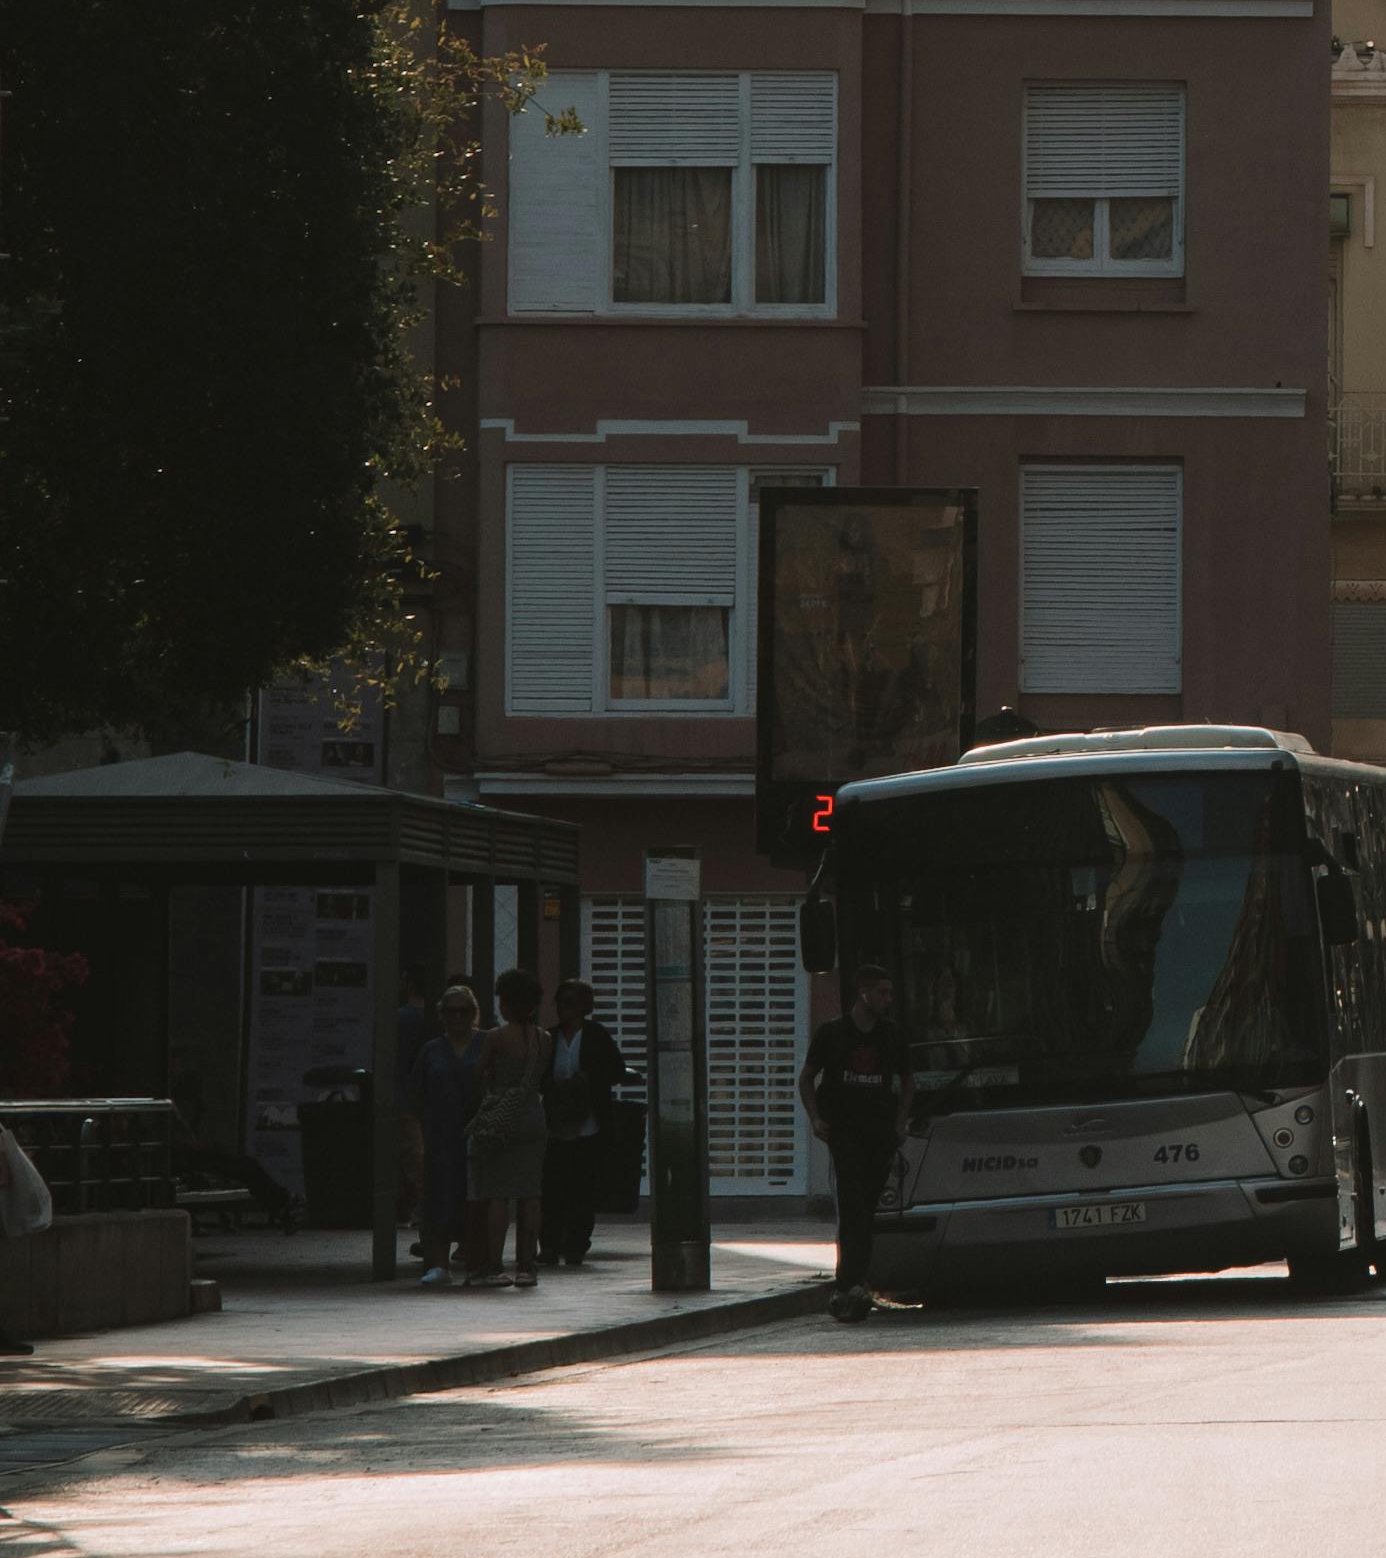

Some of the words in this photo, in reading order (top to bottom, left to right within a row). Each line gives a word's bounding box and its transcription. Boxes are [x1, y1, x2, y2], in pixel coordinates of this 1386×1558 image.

[1153, 1143, 1201, 1164] 476
[1063, 1208, 1104, 1227] 1741
[1110, 1203, 1142, 1223] FZK
